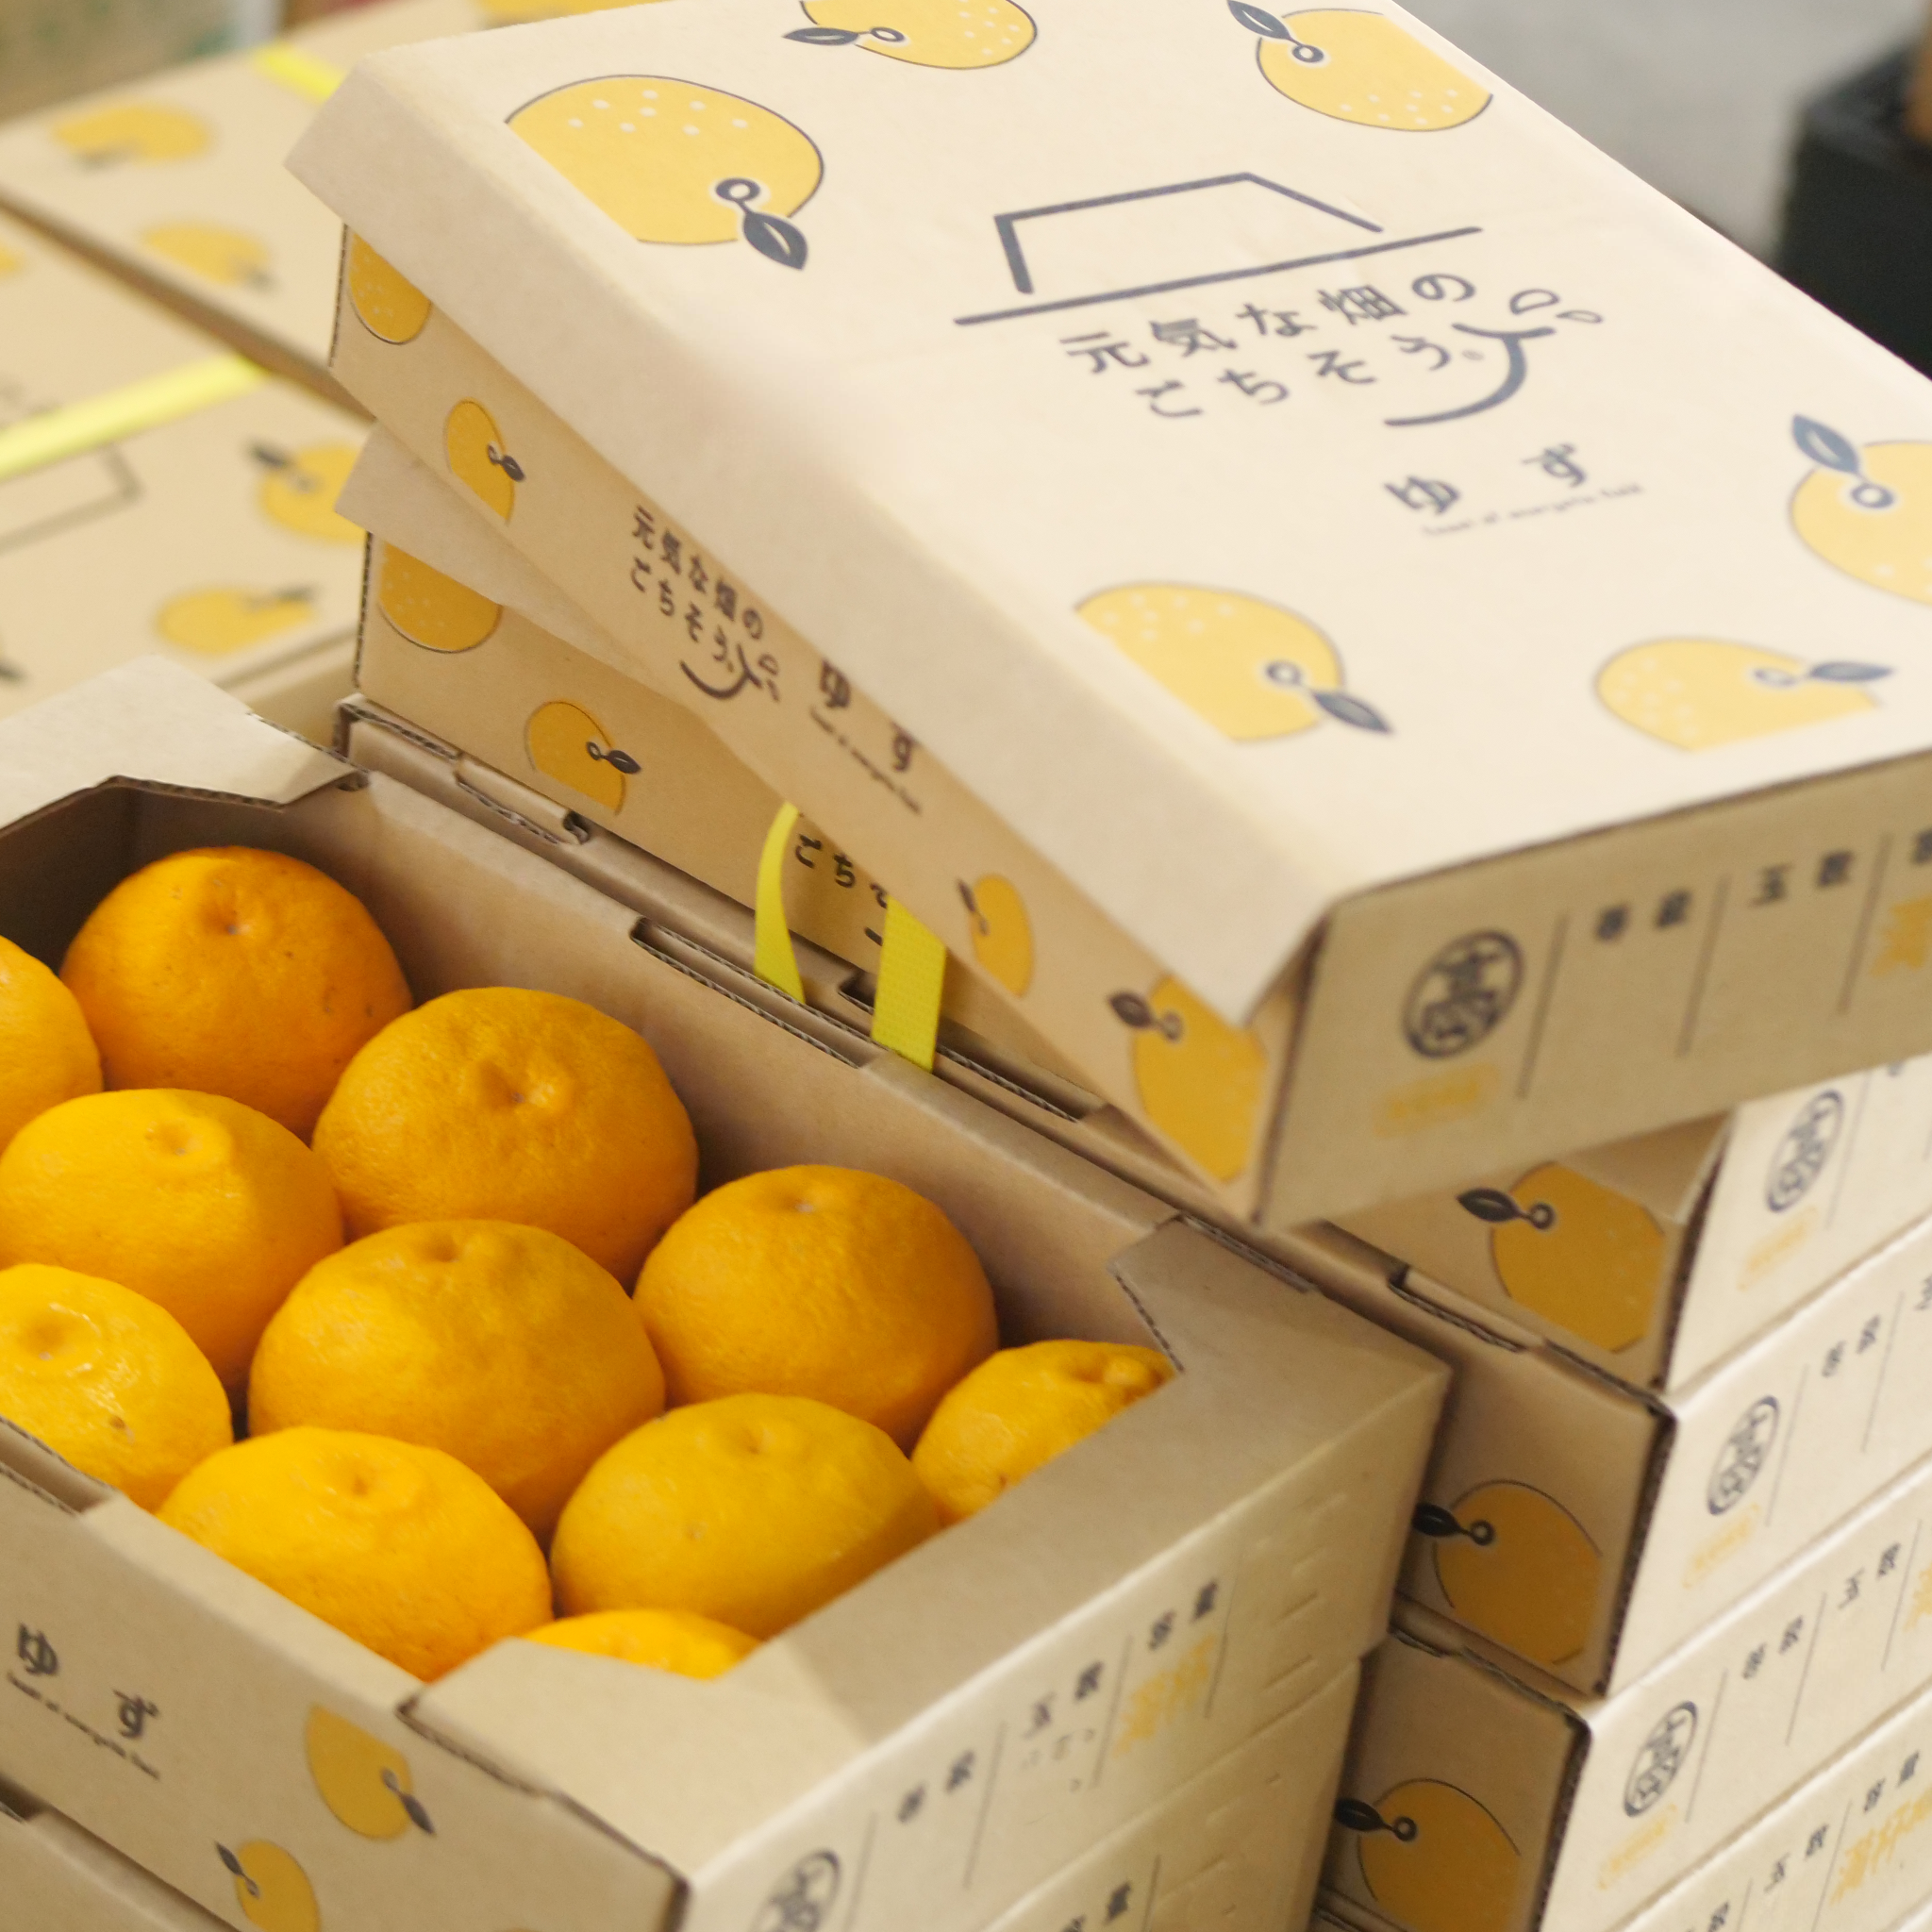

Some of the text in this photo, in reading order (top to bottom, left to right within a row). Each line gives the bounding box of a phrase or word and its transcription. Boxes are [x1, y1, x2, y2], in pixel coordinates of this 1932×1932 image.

[1058, 273, 1476, 374] 元気な畑の
